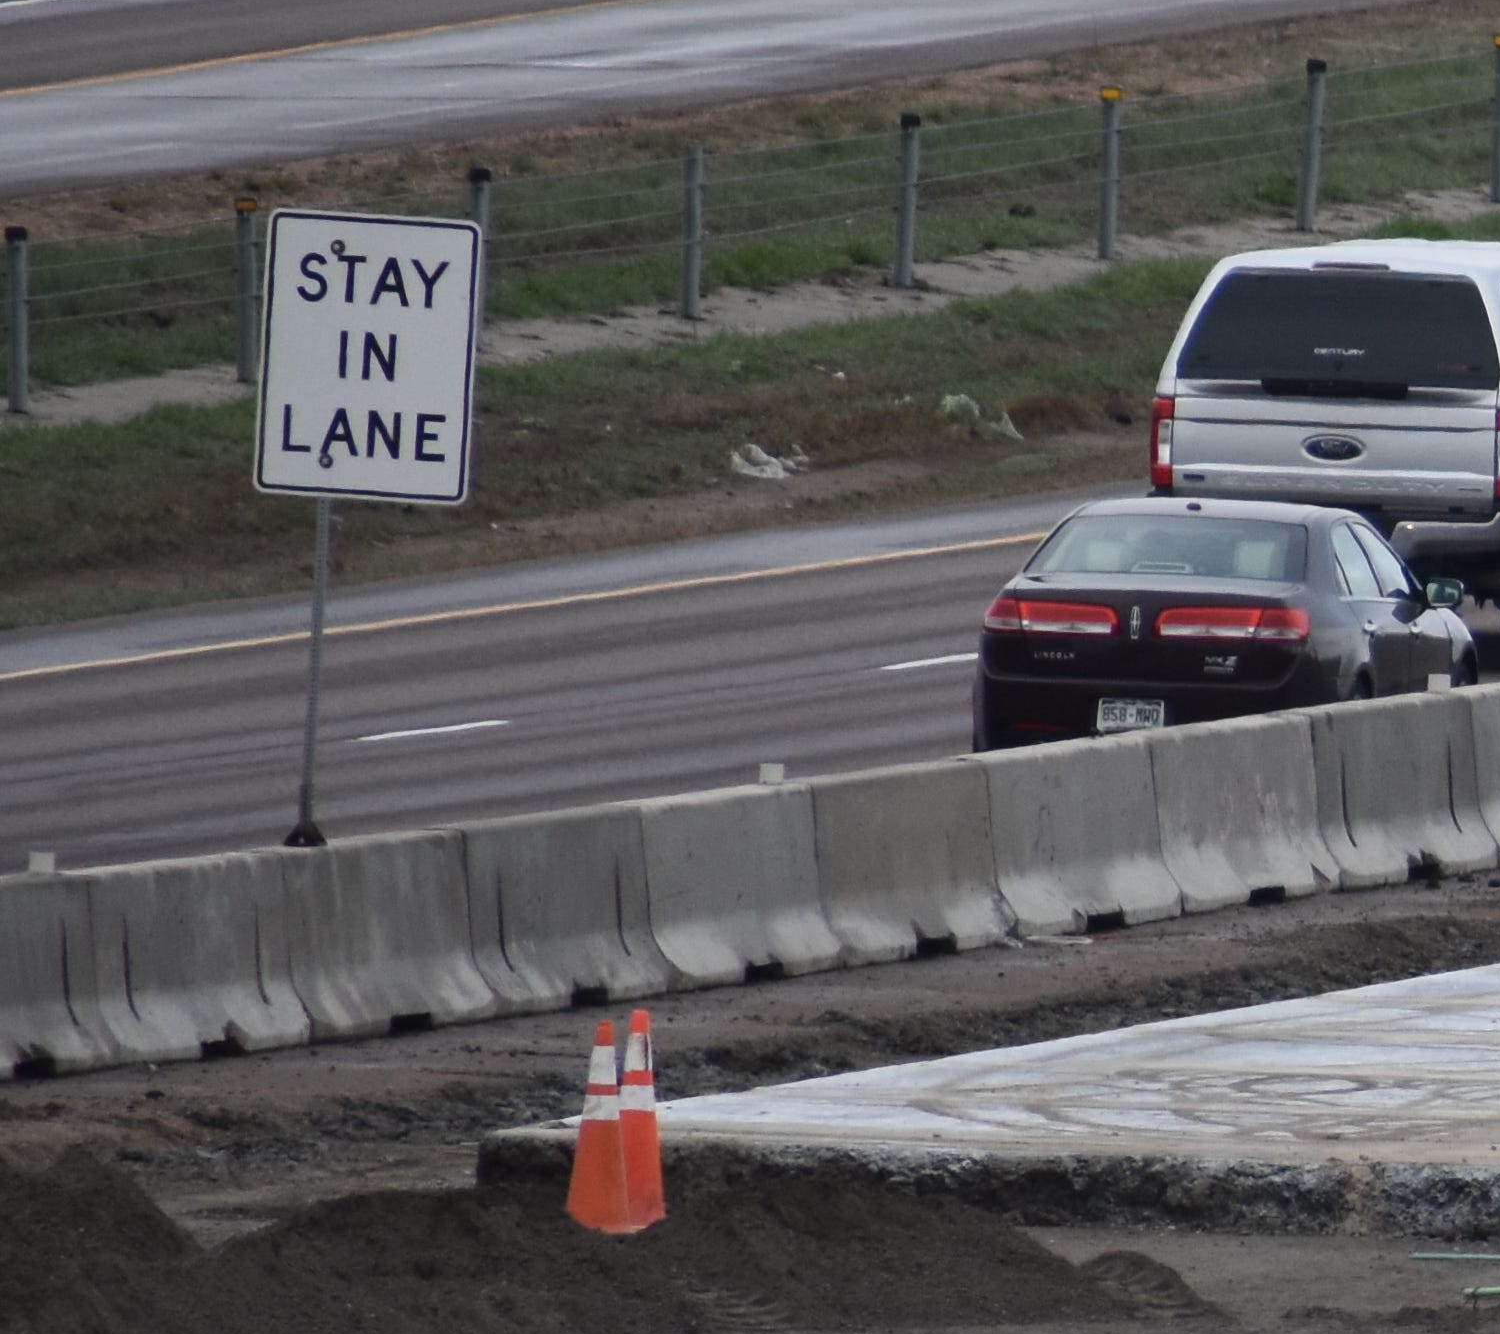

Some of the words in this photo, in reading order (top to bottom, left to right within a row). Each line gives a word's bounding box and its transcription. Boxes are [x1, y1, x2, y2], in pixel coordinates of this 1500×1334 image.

[297, 252, 449, 309] STAY
[338, 330, 397, 382] IN
[1312, 347, 1366, 356] CENTURY
[281, 404, 446, 463] LANE
[1034, 650, 1075, 660] LINCOLN
